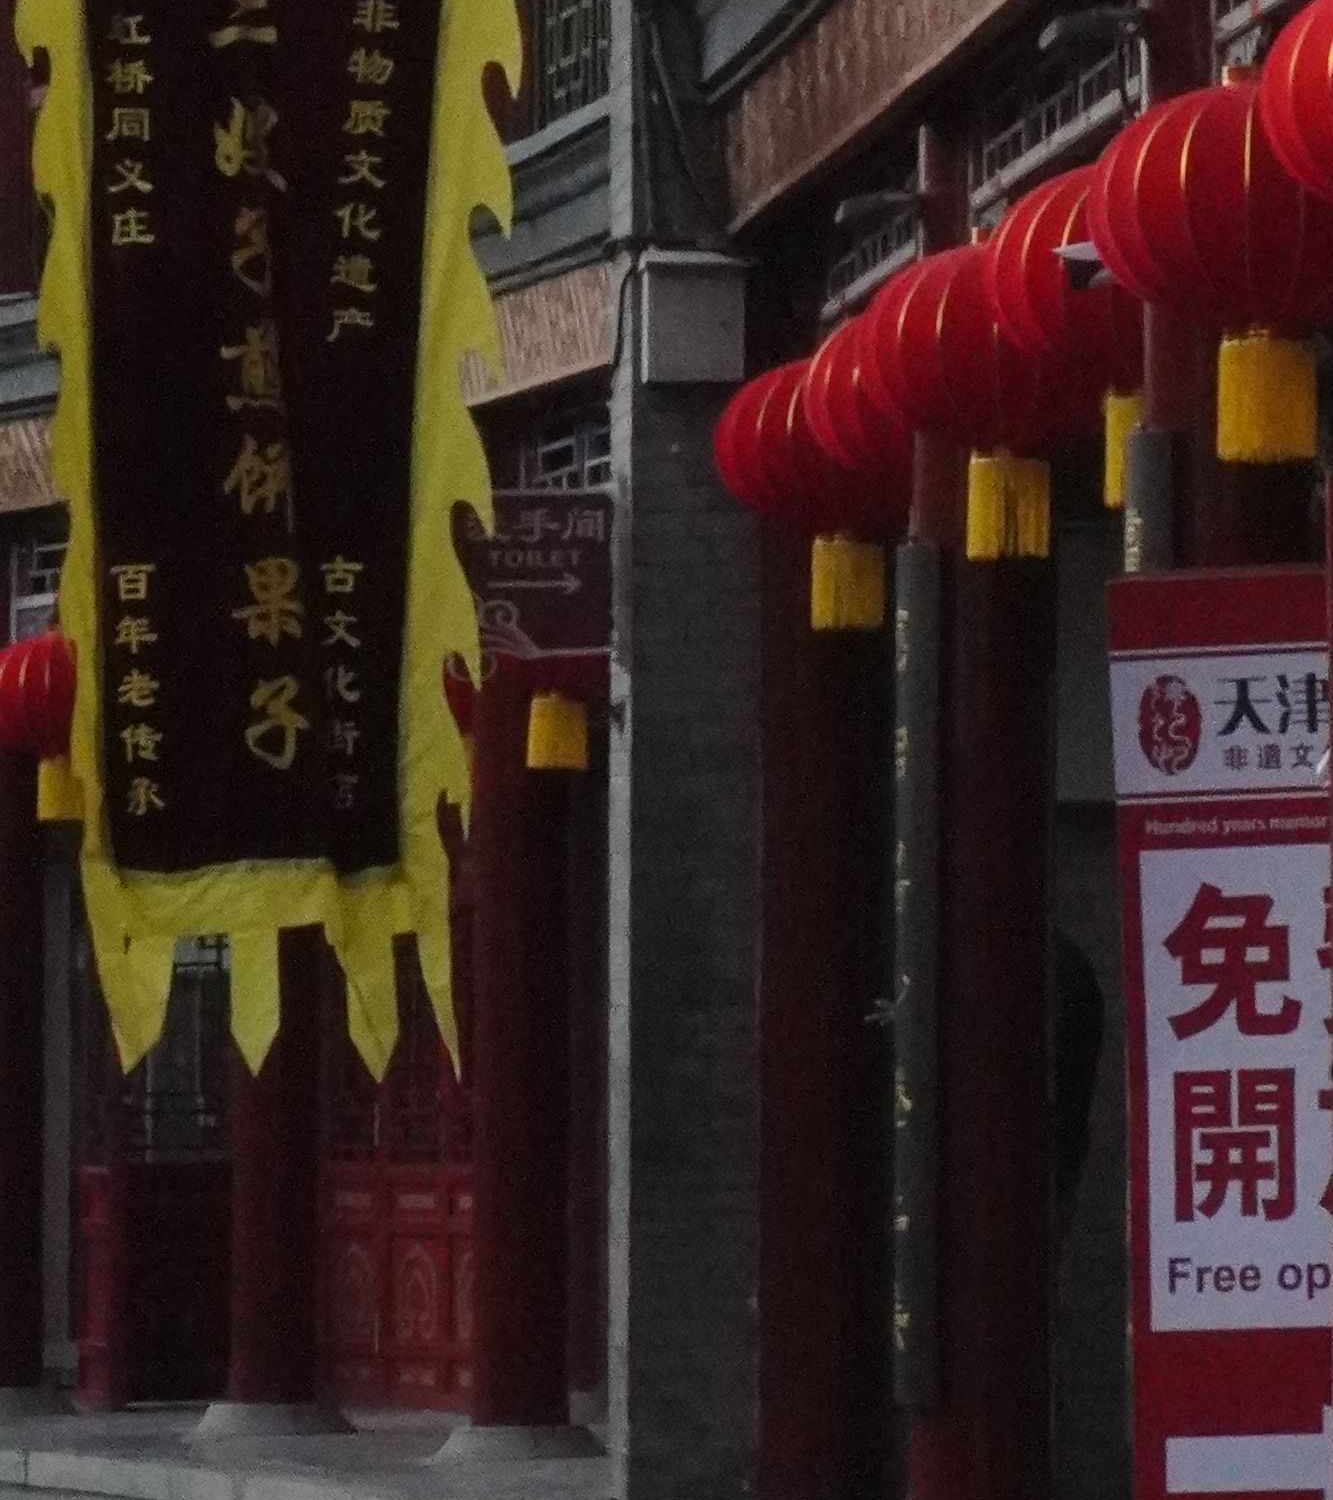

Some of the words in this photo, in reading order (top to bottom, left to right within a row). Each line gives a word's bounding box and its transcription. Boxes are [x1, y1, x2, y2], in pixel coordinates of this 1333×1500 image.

[106, 13, 156, 247] 红桥同义庄
[488, 549, 581, 569] TOILET
[110, 563, 166, 817] 百年老传承
[1167, 1256, 1263, 1296] Free
